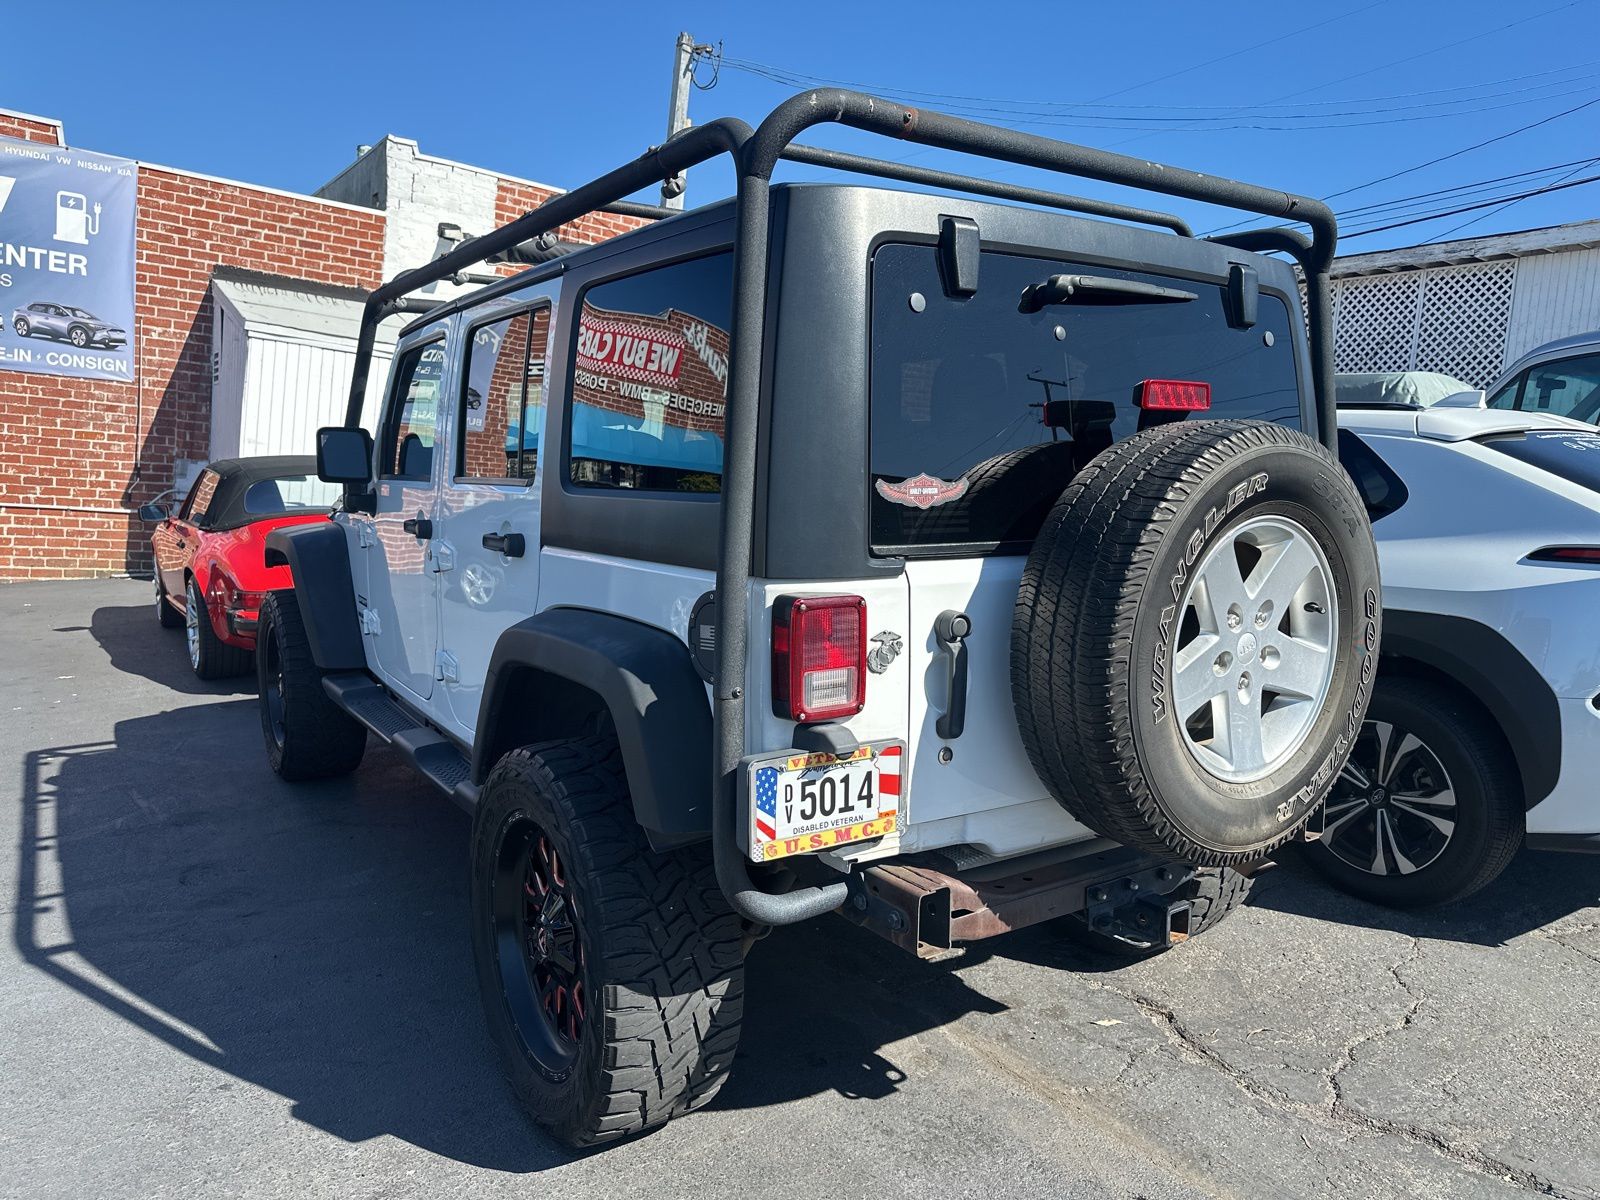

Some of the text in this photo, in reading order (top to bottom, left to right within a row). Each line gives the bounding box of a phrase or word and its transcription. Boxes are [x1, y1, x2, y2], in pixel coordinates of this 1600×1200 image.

[4, 146, 132, 177] HYUNDAI VW NISSAN KIA
[0, 242, 88, 276] NTER
[46, 352, 127, 373] CONSIGN
[1152, 472, 1269, 724] WRANGLER
[1276, 587, 1377, 823] GOODYEAR
[800, 771, 873, 820] 5014
[793, 814, 864, 834] DISABLED VETERAN
